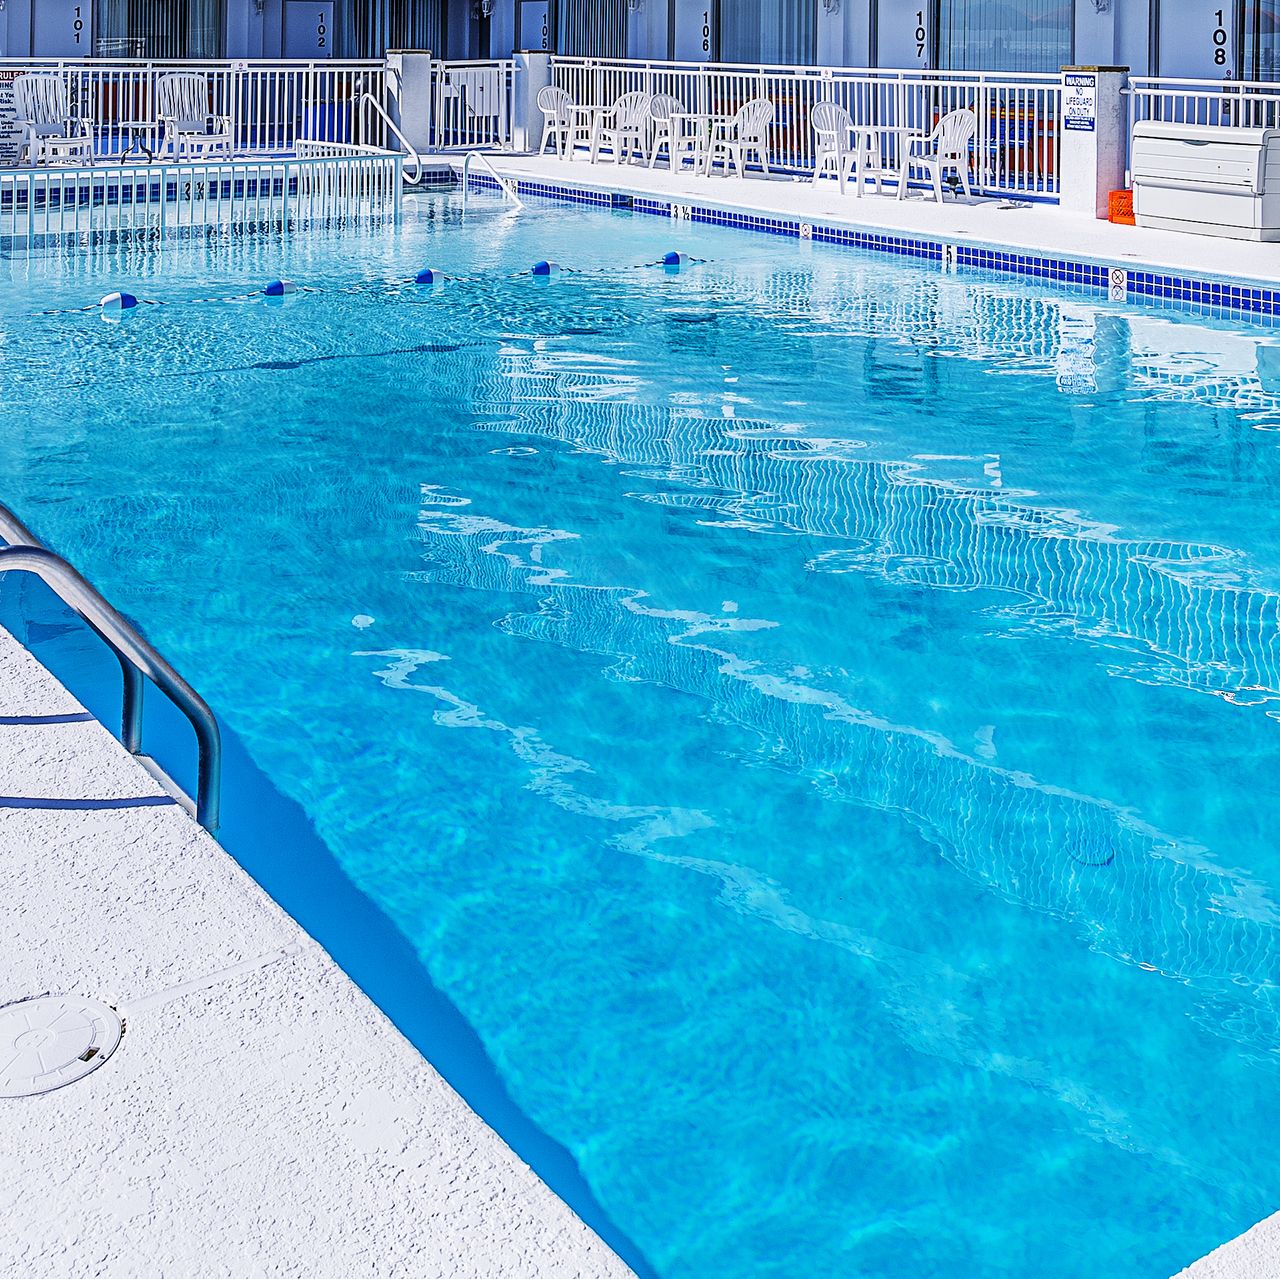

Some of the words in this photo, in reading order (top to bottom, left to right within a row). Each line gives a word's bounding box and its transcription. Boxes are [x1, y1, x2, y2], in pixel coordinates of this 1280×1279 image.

[73, 7, 83, 44] 101
[317, 12, 326, 47] 102
[702, 11, 710, 51] 106
[915, 11, 926, 57] 107
[1212, 9, 1227, 65] 108
[1066, 76, 1095, 87] WARNING
[1075, 88, 1084, 96] NO
[673, 204, 679, 219] 3
